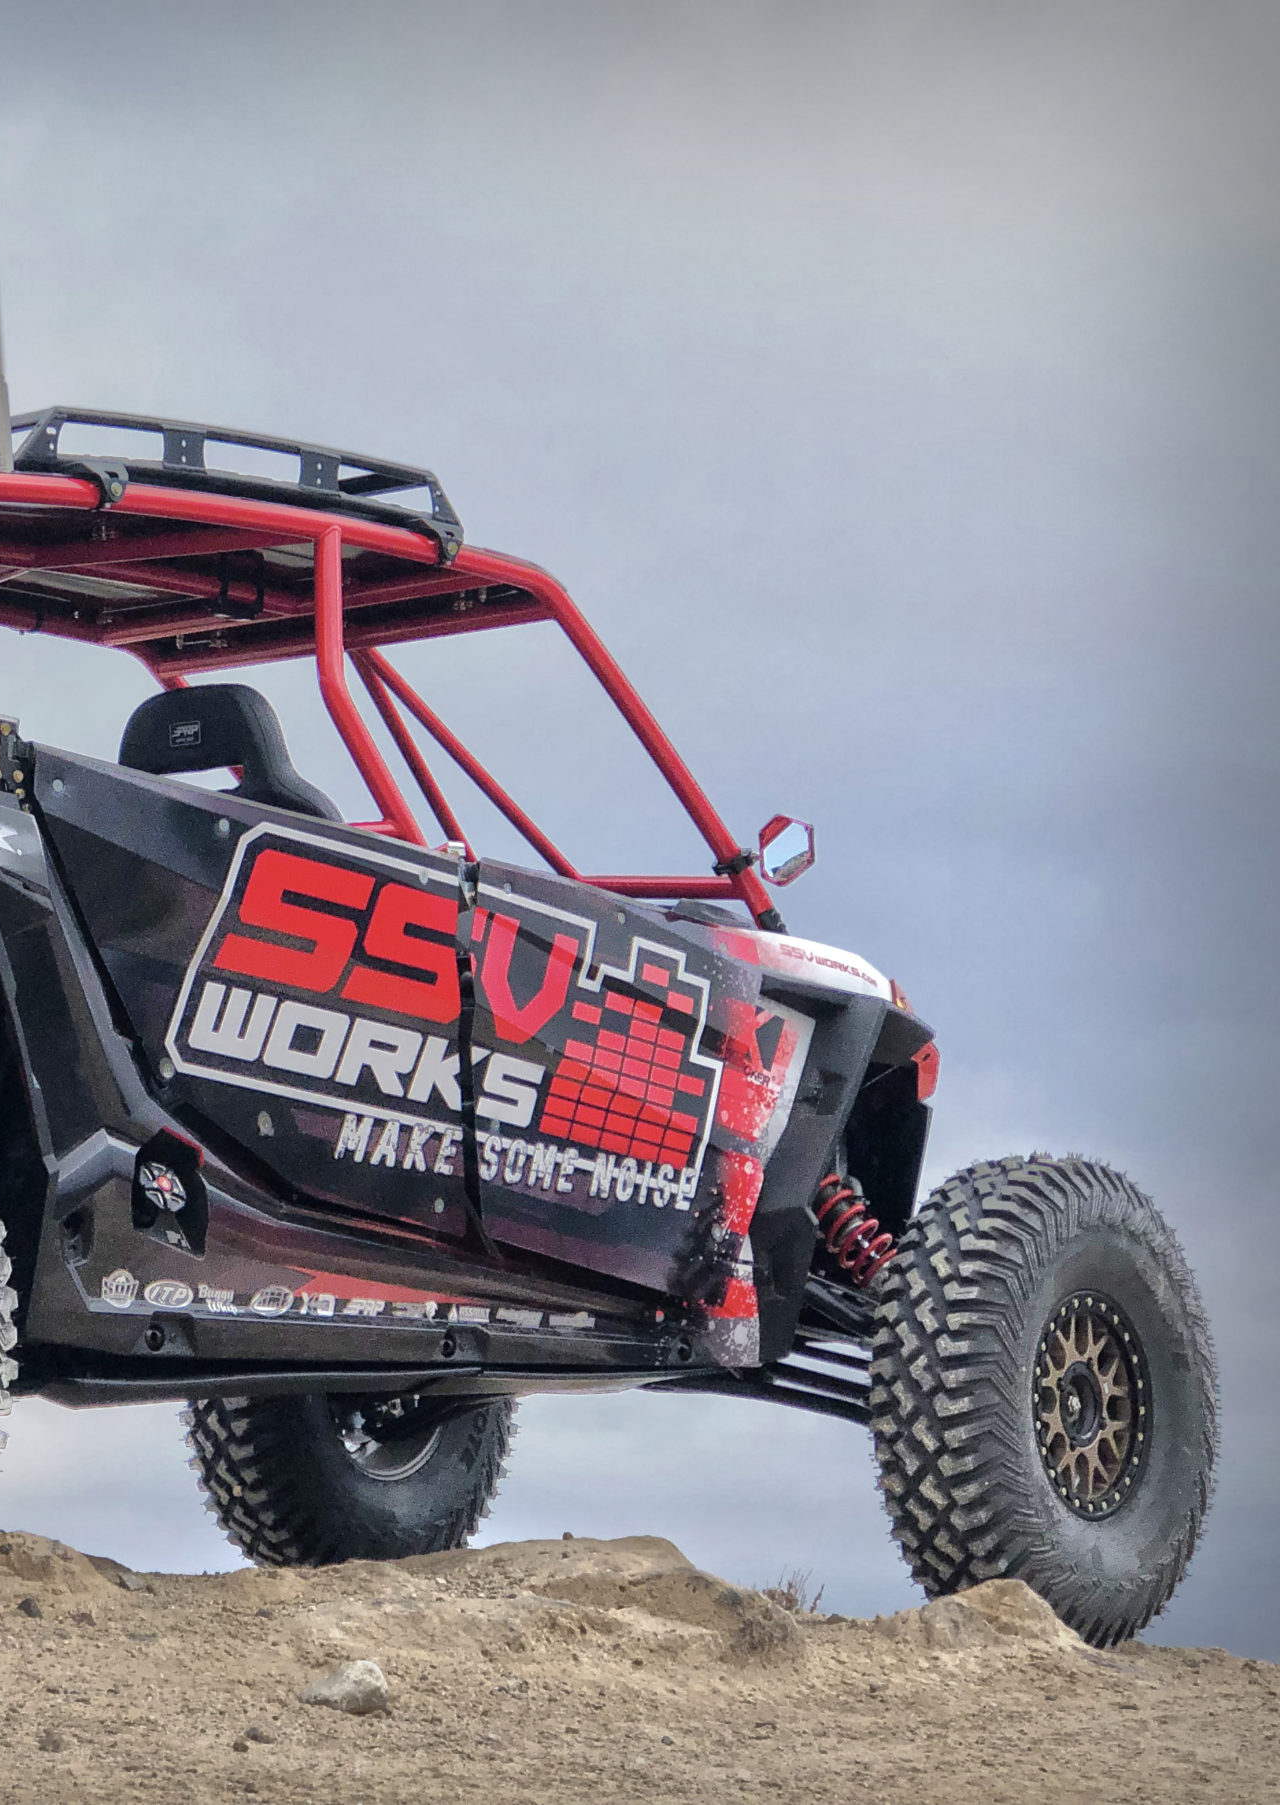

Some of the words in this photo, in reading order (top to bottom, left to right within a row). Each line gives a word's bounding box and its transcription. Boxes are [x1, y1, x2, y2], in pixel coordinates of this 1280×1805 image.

[213, 848, 579, 1044] SSV
[188, 981, 546, 1129] WORKS
[333, 1113, 464, 1175] MAKE
[478, 1134, 579, 1194] SOME
[588, 1152, 697, 1212] NOISE
[149, 1285, 189, 1304] ITP
[199, 1284, 234, 1303] Buggy
